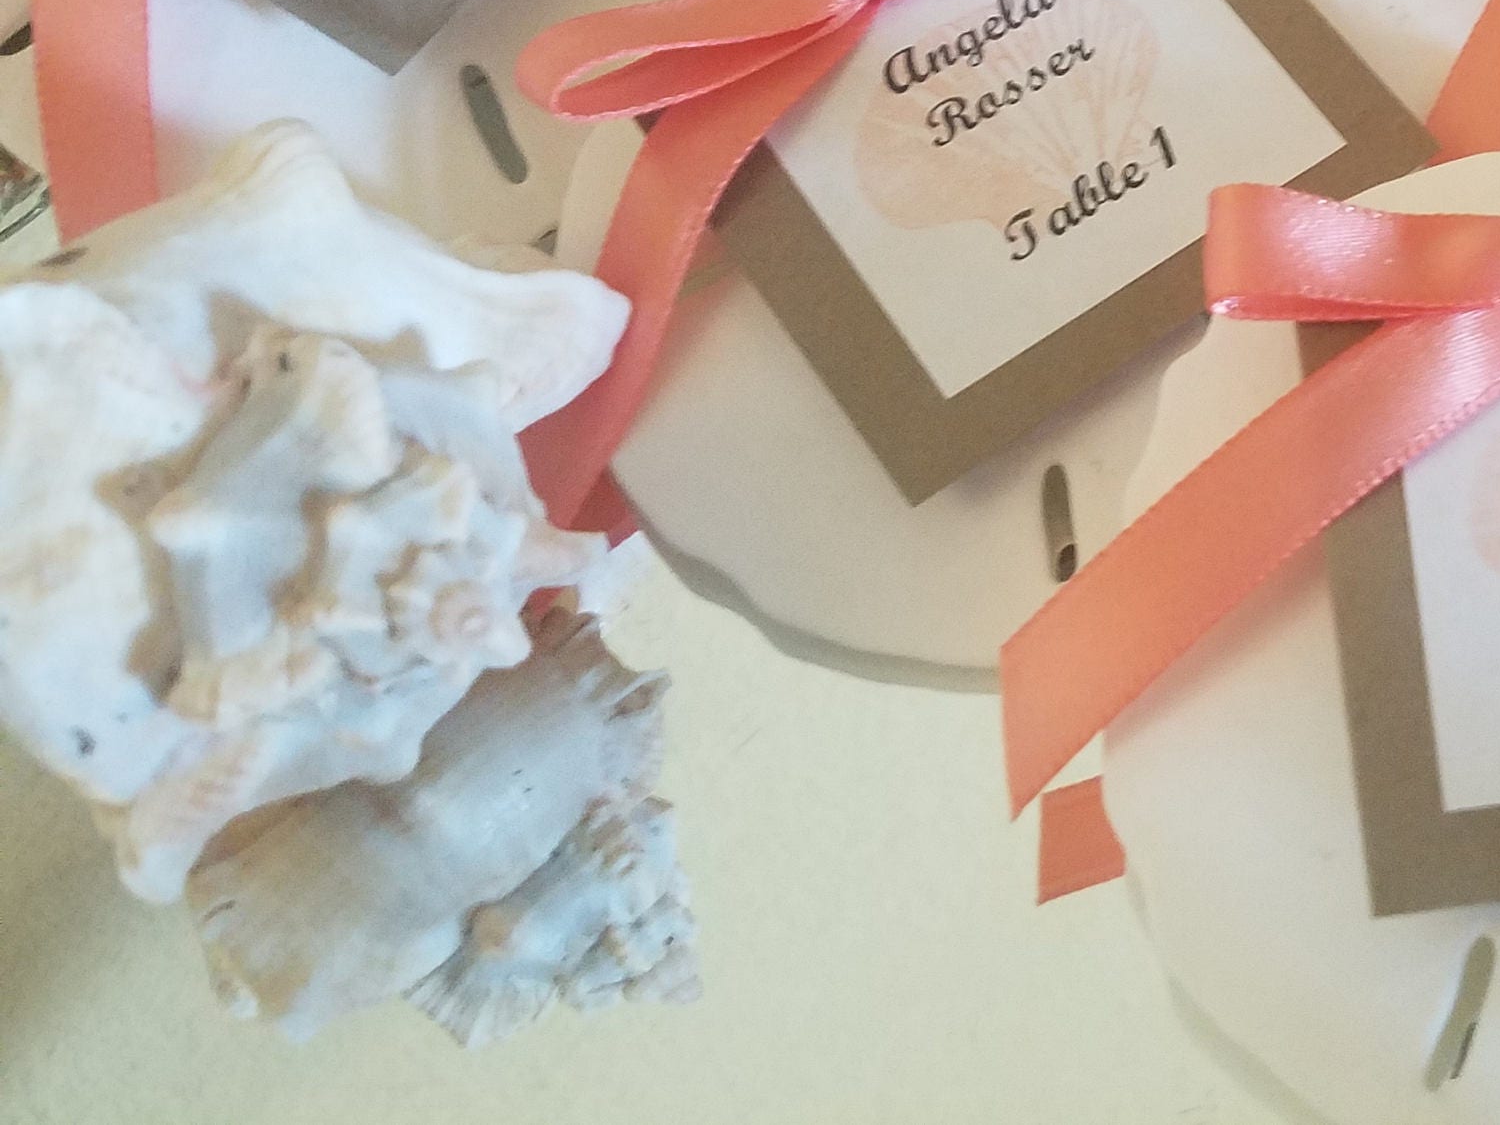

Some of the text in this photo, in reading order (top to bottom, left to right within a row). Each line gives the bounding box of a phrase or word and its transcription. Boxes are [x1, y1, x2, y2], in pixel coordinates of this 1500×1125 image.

[926, 39, 1095, 147] Rosser
[1004, 126, 1176, 260] Table 1
